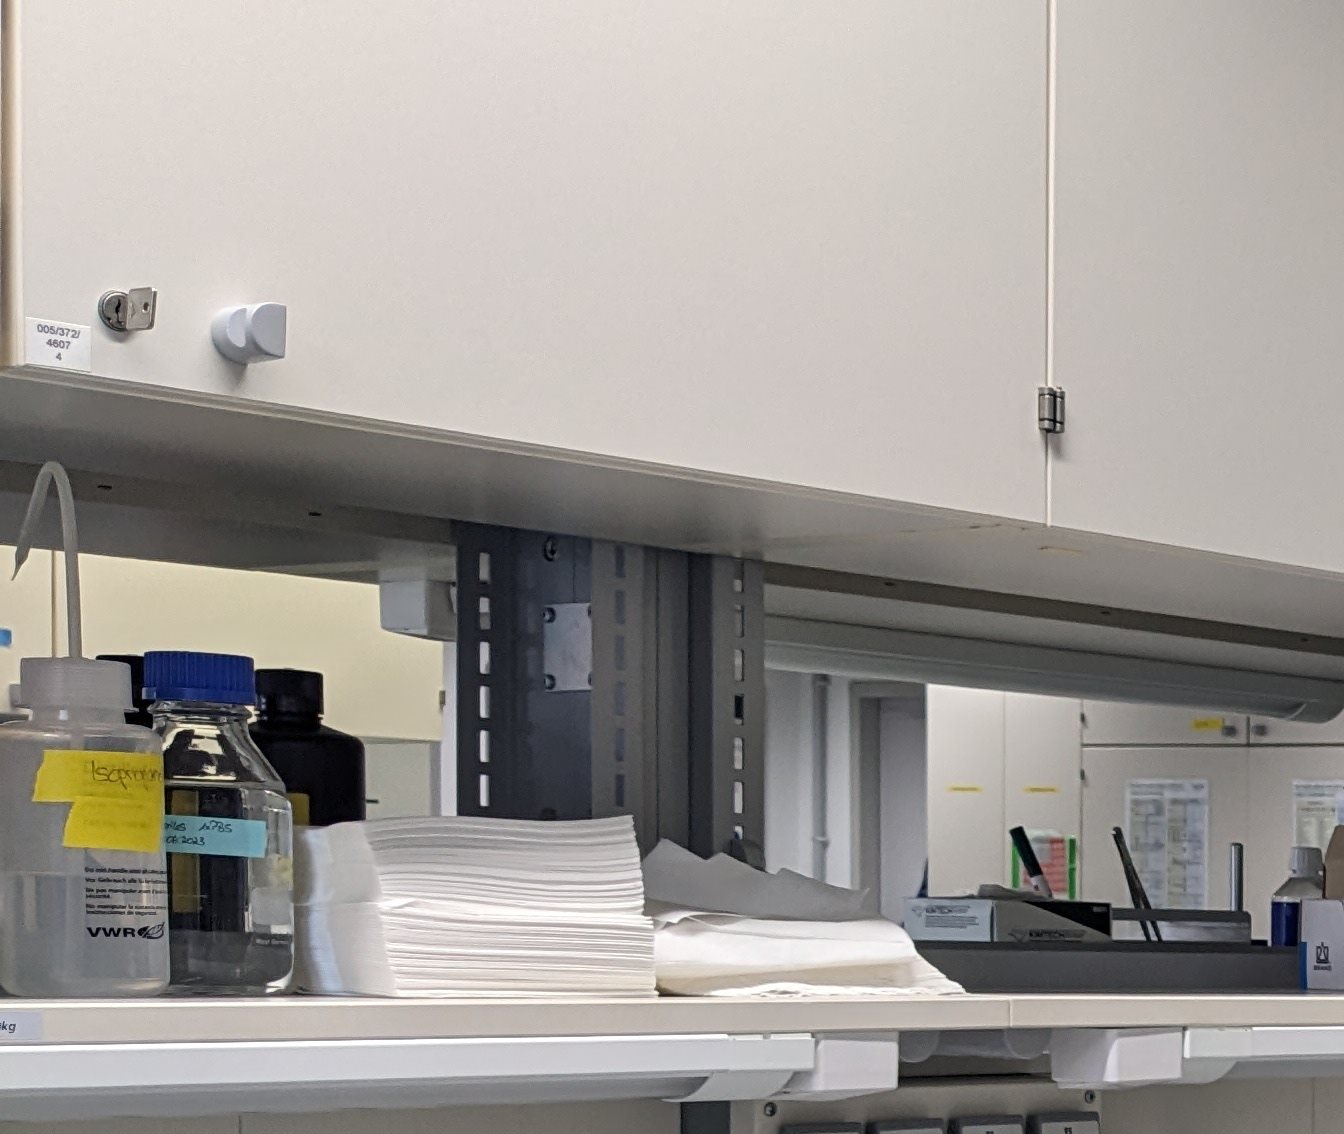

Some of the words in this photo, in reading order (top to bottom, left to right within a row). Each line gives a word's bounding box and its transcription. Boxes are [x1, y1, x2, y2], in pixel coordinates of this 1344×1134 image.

[36, 323, 81, 339] 005/372/
[55, 351, 63, 361] 4
[86, 926, 136, 938] VWR
[0, 1020, 16, 1034] kg
